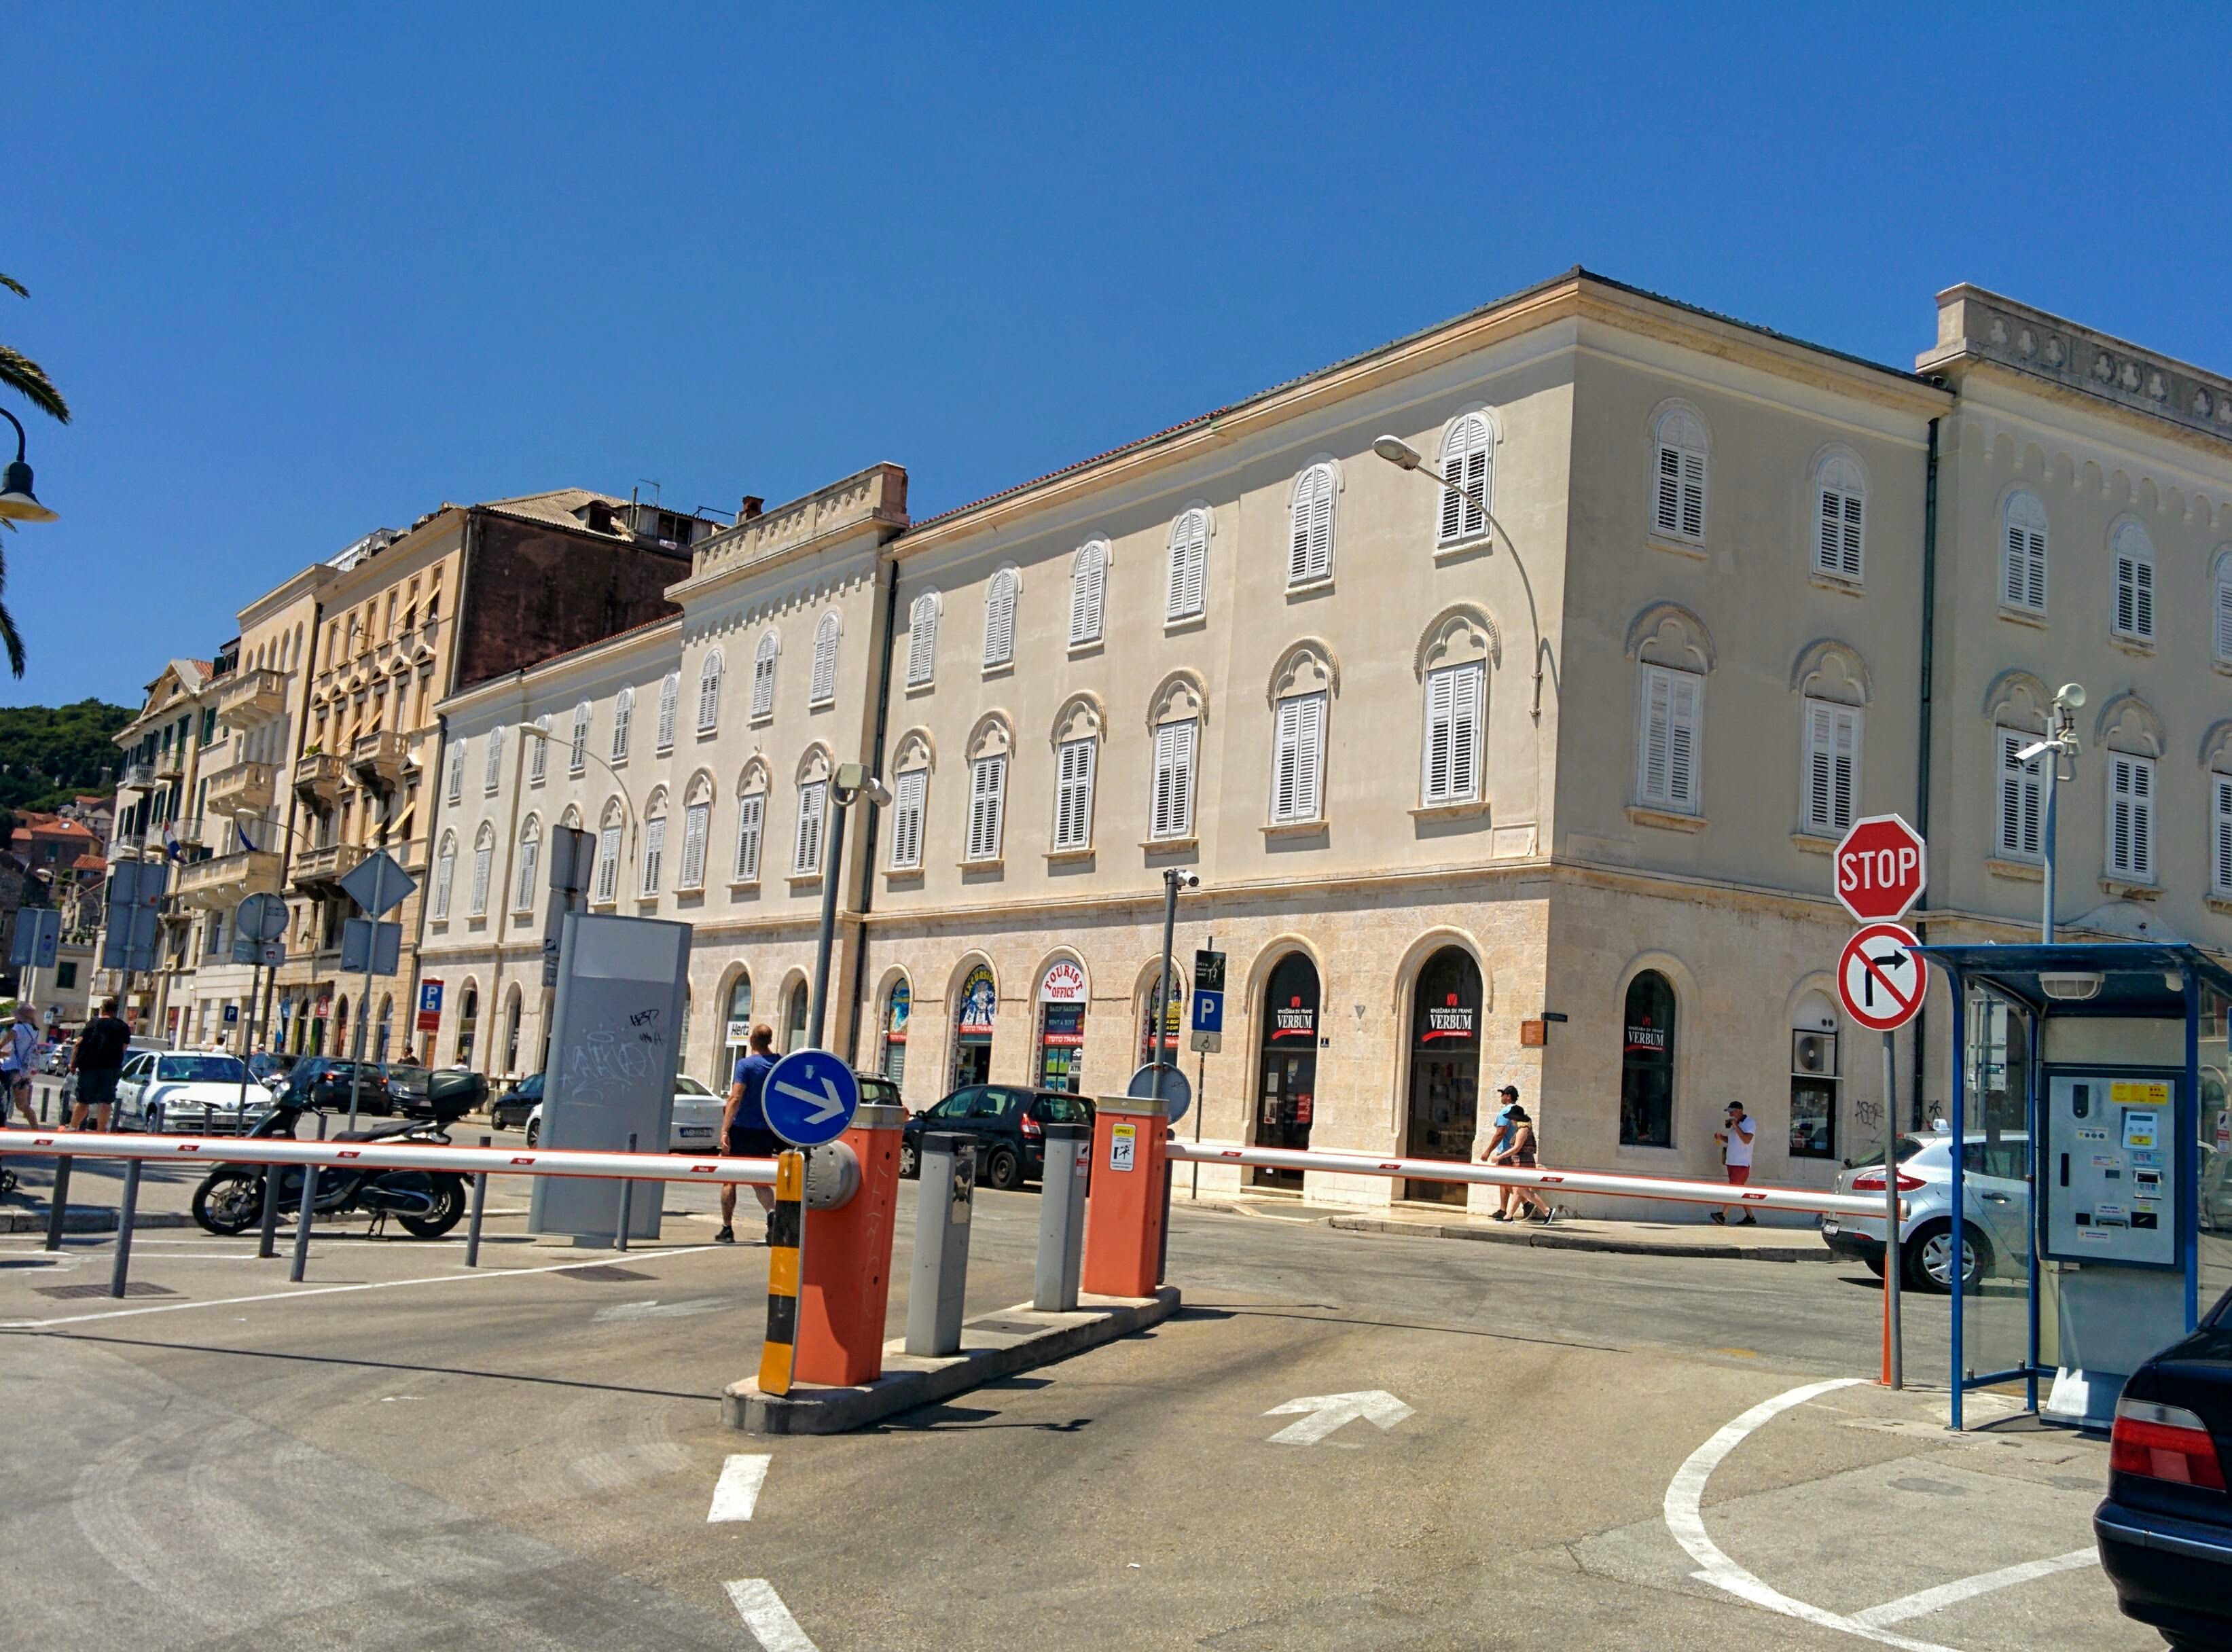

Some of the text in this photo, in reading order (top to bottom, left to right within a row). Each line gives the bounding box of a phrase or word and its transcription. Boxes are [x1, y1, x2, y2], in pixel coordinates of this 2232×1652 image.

[1841, 847, 1917, 891] STOP
[1044, 965, 1083, 991] TOURIST
[427, 986, 438, 1000] P
[1051, 986, 1075, 998] OFFICE
[228, 1008, 235, 1019] P
[1200, 998, 1214, 1023] P
[1277, 1015, 1313, 1028] VERBUM
[1429, 1014, 1473, 1030] VERBUM
[731, 1024, 749, 1036] Hertz
[1628, 1031, 1664, 1046] VERBUM
